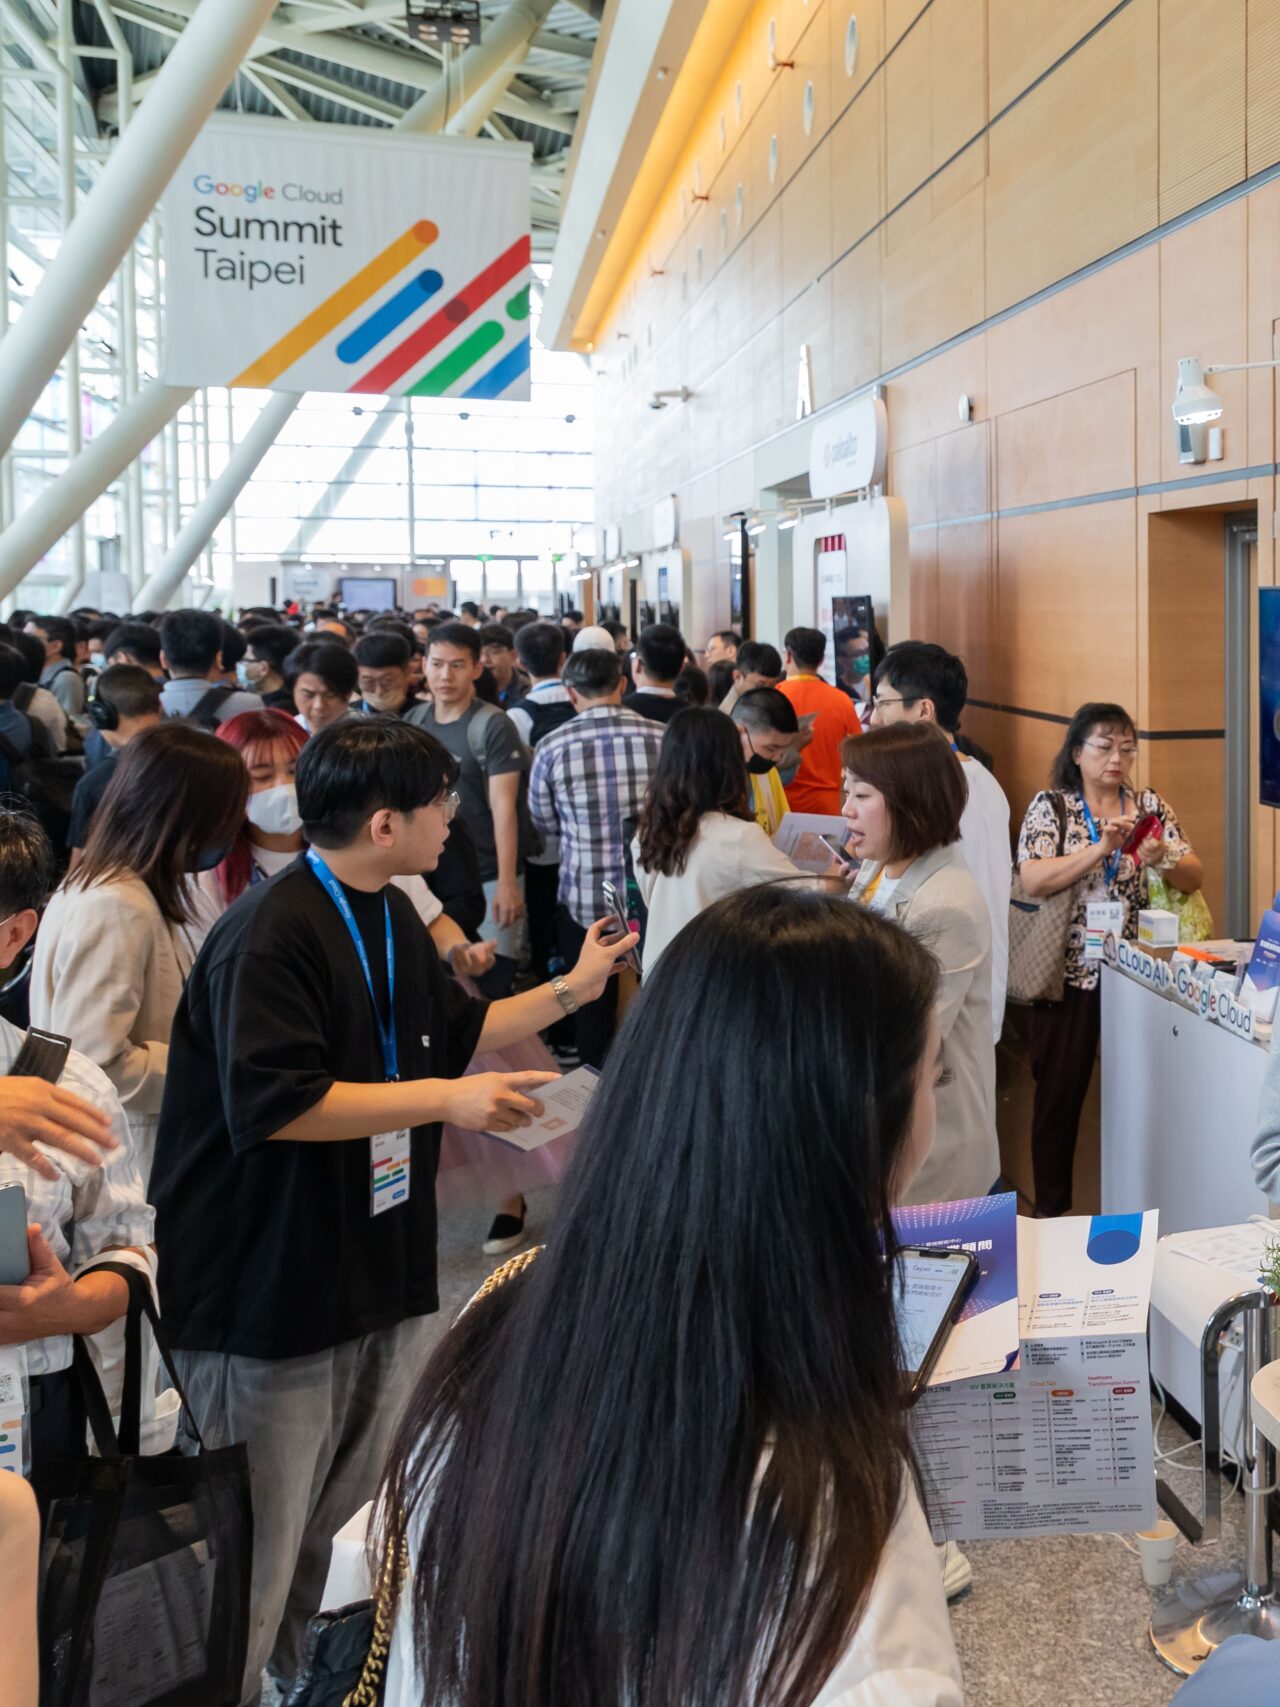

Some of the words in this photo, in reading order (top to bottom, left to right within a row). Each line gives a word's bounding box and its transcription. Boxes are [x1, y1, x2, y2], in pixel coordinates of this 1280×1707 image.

[193, 174, 275, 203] Google
[281, 182, 343, 205] Cloud
[194, 206, 343, 247] Summit
[194, 248, 304, 290] Taipei
[1117, 944, 1151, 979] CLOUD
[1176, 968, 1217, 1015] Google
[1218, 993, 1252, 1034] Cloud
